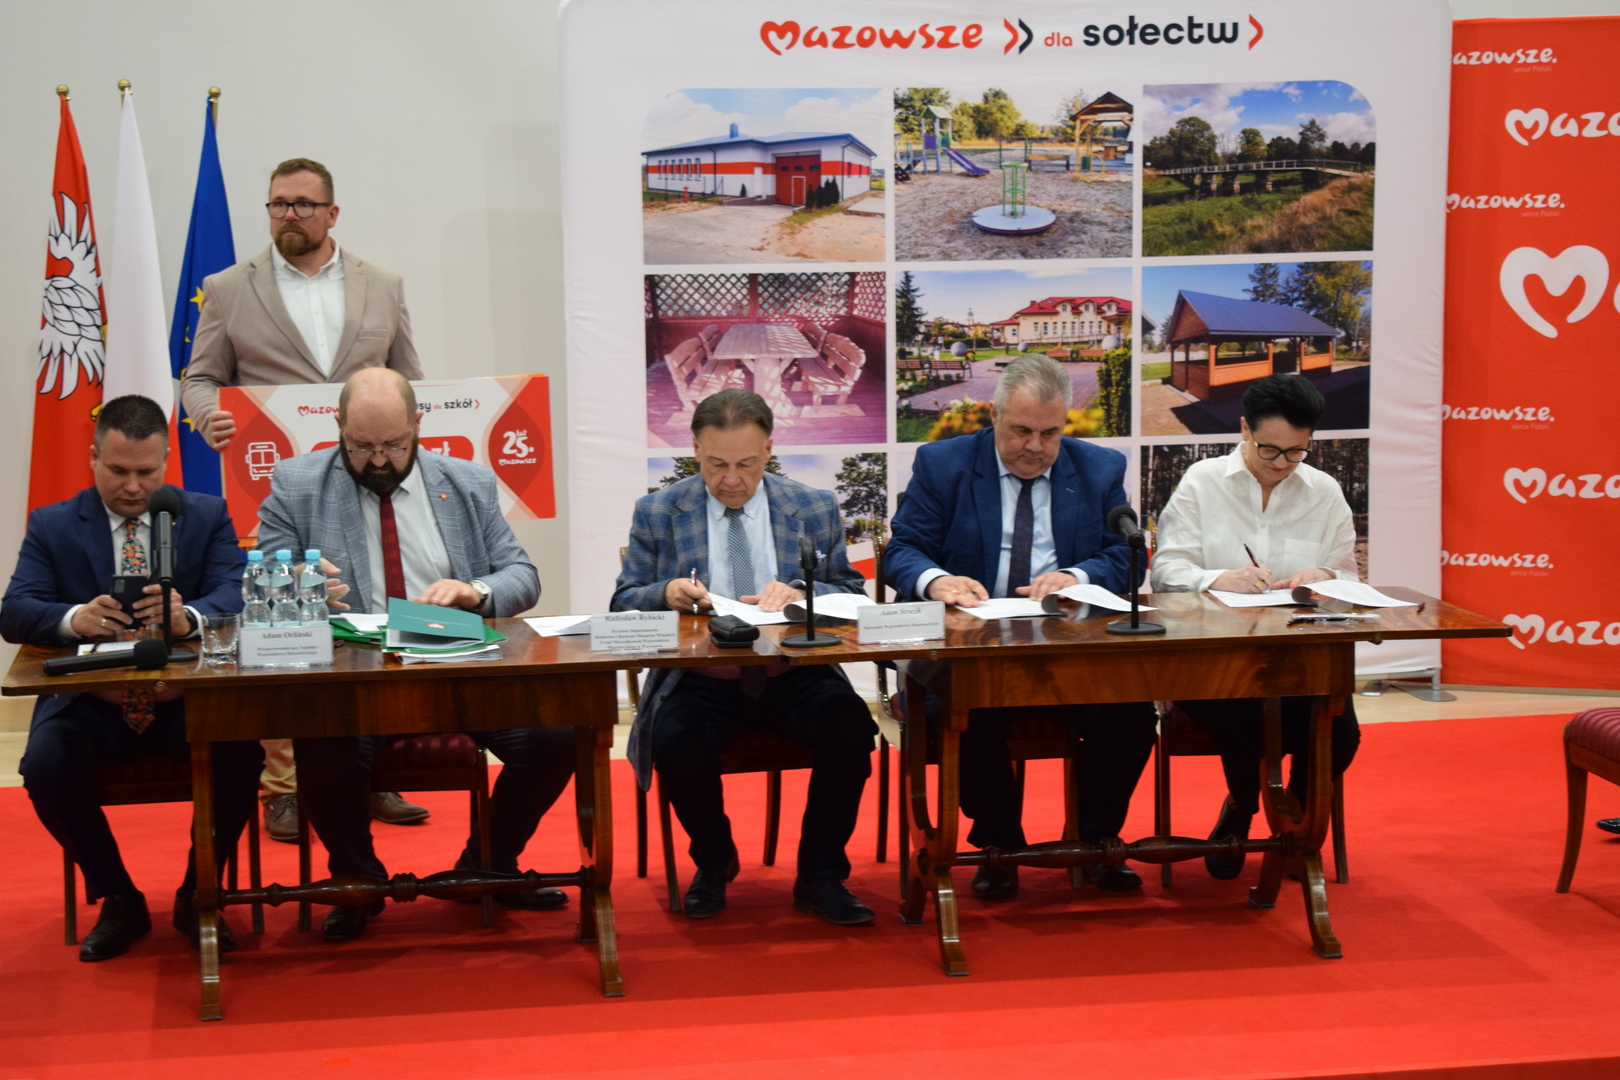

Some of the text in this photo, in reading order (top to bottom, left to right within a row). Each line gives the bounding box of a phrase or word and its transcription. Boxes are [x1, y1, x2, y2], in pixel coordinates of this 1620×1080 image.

[760, 15, 1240, 56] Mazowsze dla sołectw
[1452, 48, 1558, 65] azowsze.
[297, 405, 340, 417] Mazow
[444, 398, 472, 409] szkół
